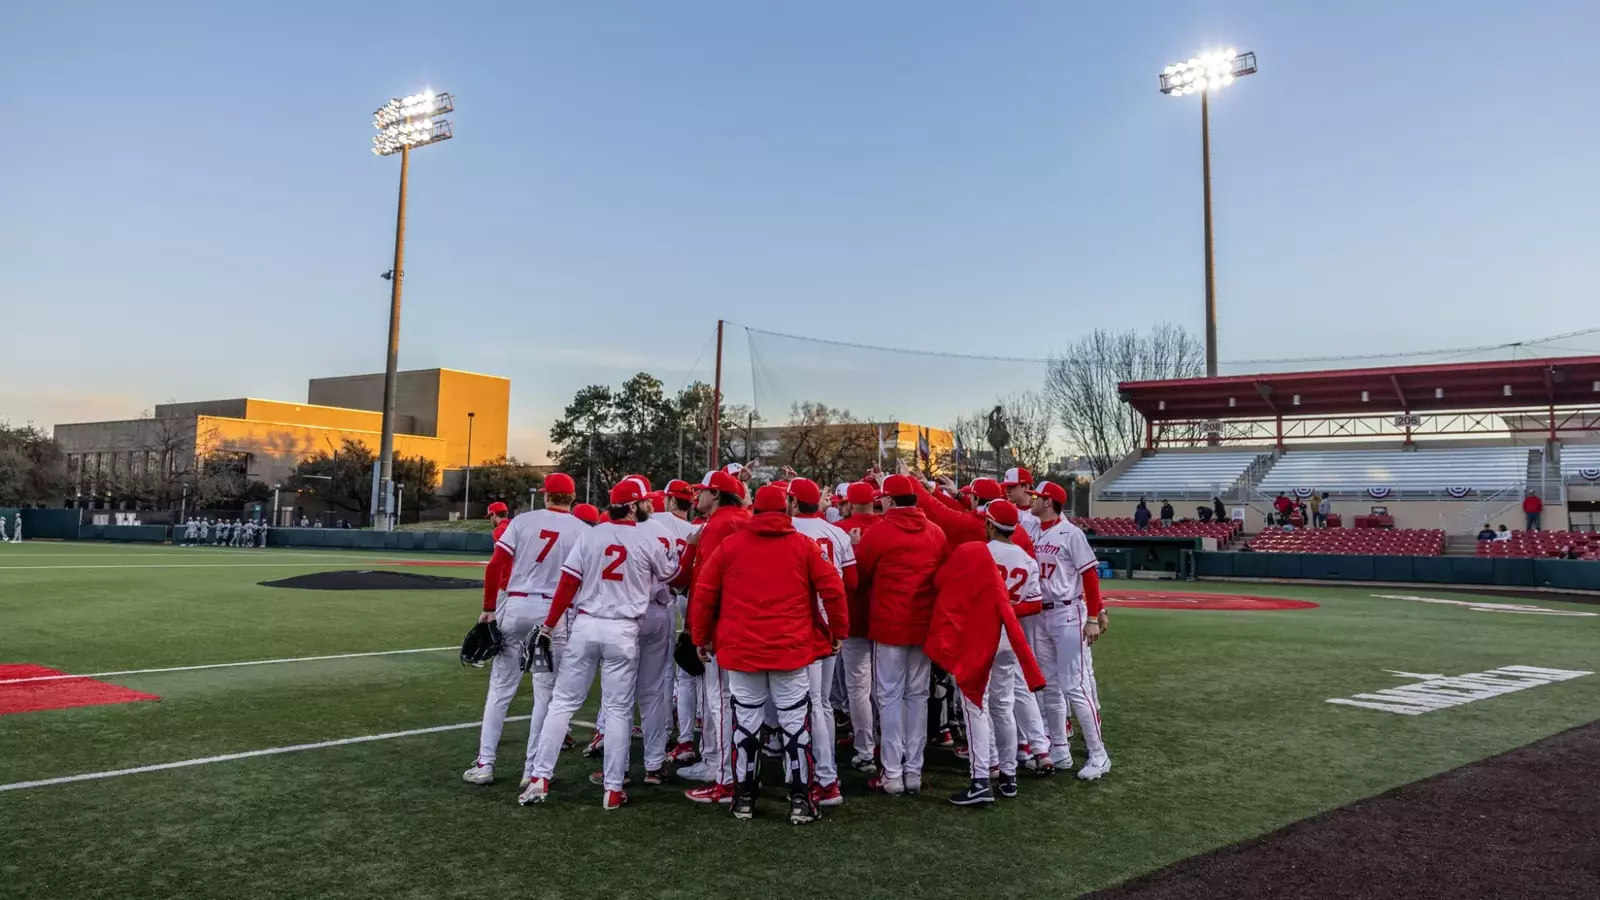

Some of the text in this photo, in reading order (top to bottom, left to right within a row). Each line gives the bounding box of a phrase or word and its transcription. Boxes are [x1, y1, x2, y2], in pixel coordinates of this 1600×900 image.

[1203, 422, 1220, 431] 208
[1398, 416, 1418, 425] 206
[535, 529, 560, 563] 7
[602, 544, 627, 581] 2
[1039, 562, 1057, 580] 17
